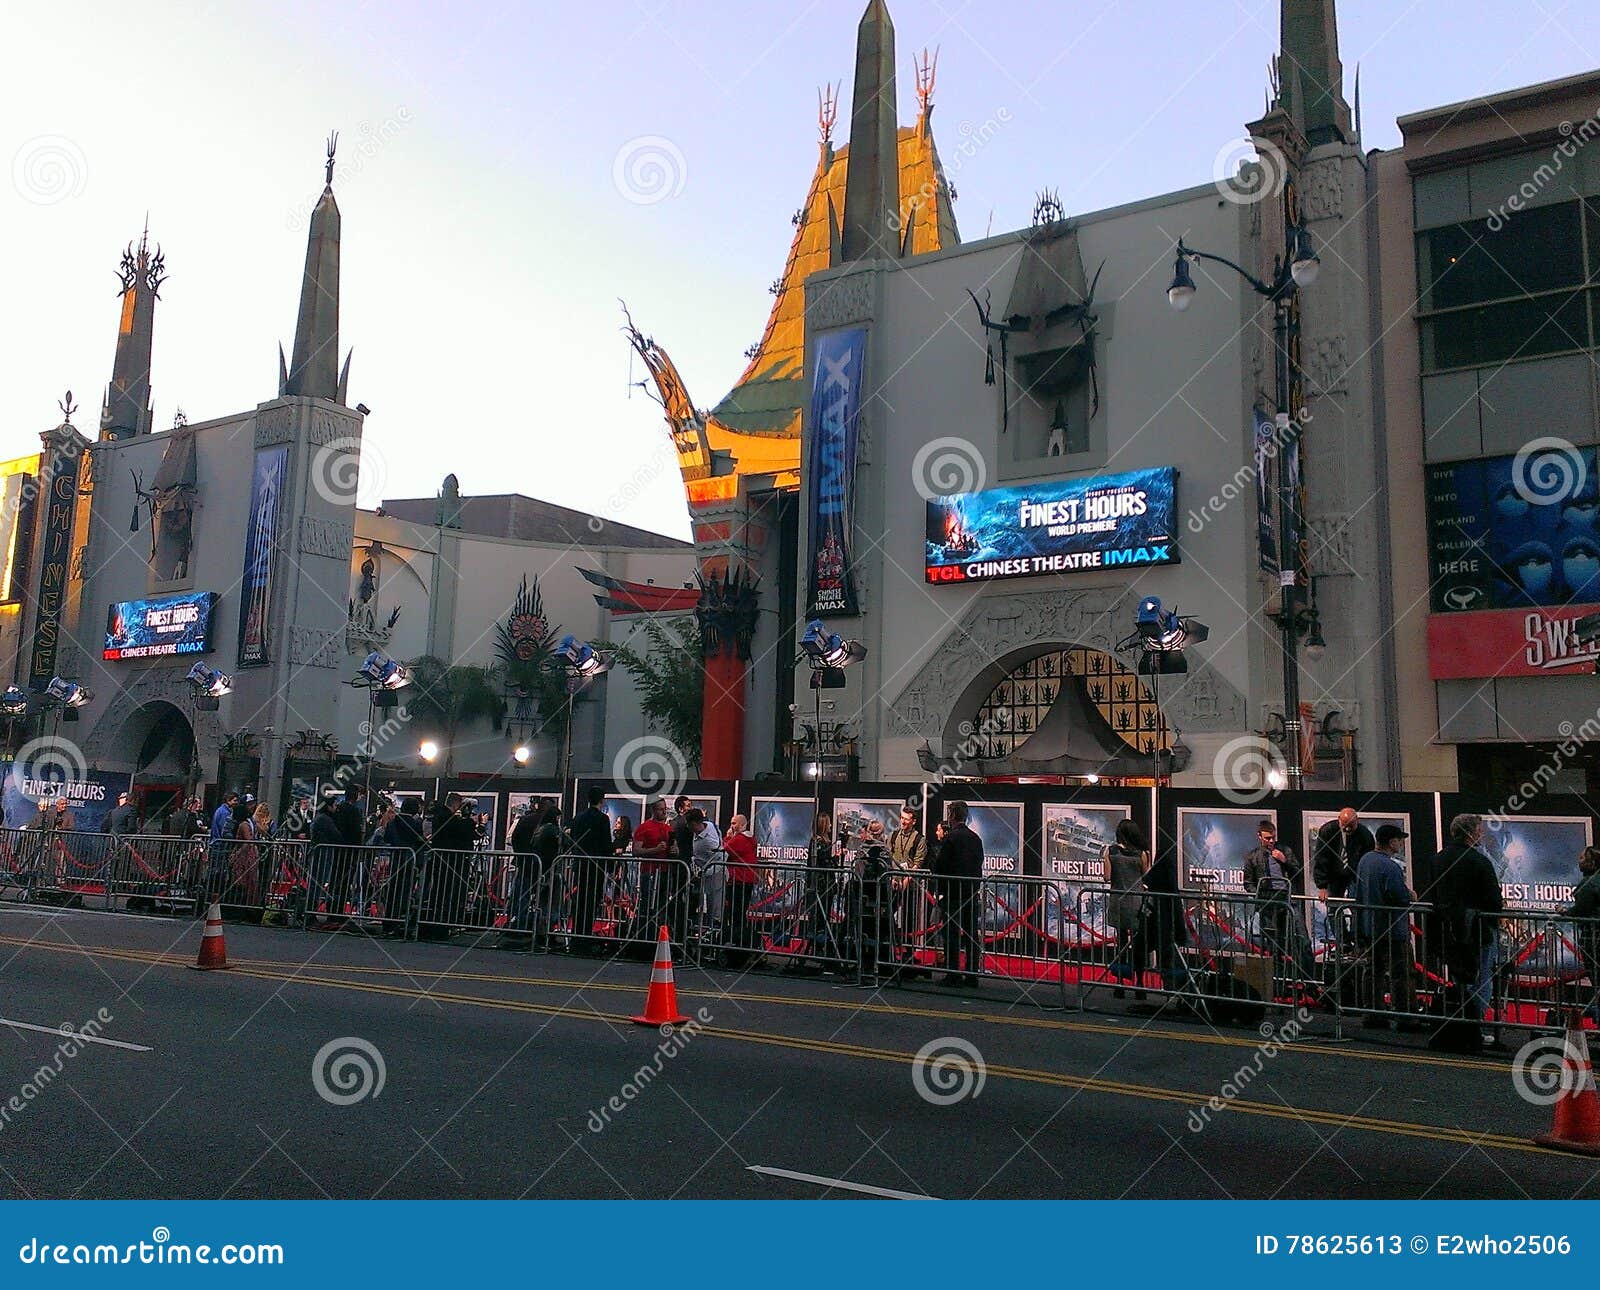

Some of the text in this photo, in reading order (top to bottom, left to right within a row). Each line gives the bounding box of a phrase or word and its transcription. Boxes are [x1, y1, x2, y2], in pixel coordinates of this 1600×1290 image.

[819, 347, 851, 515] IMAX
[1433, 470, 1455, 479] DIVE
[1434, 493, 1457, 502] INTO
[1020, 491, 1147, 528] FINEST HOURS
[1048, 520, 1117, 537] WORLD PREMIERE
[1436, 515, 1476, 527] WYLAND
[1437, 540, 1486, 550] GALLERIES
[927, 544, 1169, 581] TCL CHINESE THEATRE IMAX
[1439, 560, 1479, 574] HERE
[35, 475, 74, 676] CHINESE
[815, 600, 845, 611] IMAX
[145, 606, 199, 627] FINEST HOURS
[1525, 613, 1600, 666] SWE
[103, 641, 204, 660] TCL CHINESE THEATRE IMAX
[21, 779, 106, 801] FINEST HOURS
[756, 846, 808, 860] FINEST HOURS
[983, 856, 1015, 871] HOURS
[1052, 860, 1085, 874] FINEST
[1500, 883, 1530, 899] NEST
[1506, 900, 1528, 909] WORLD
